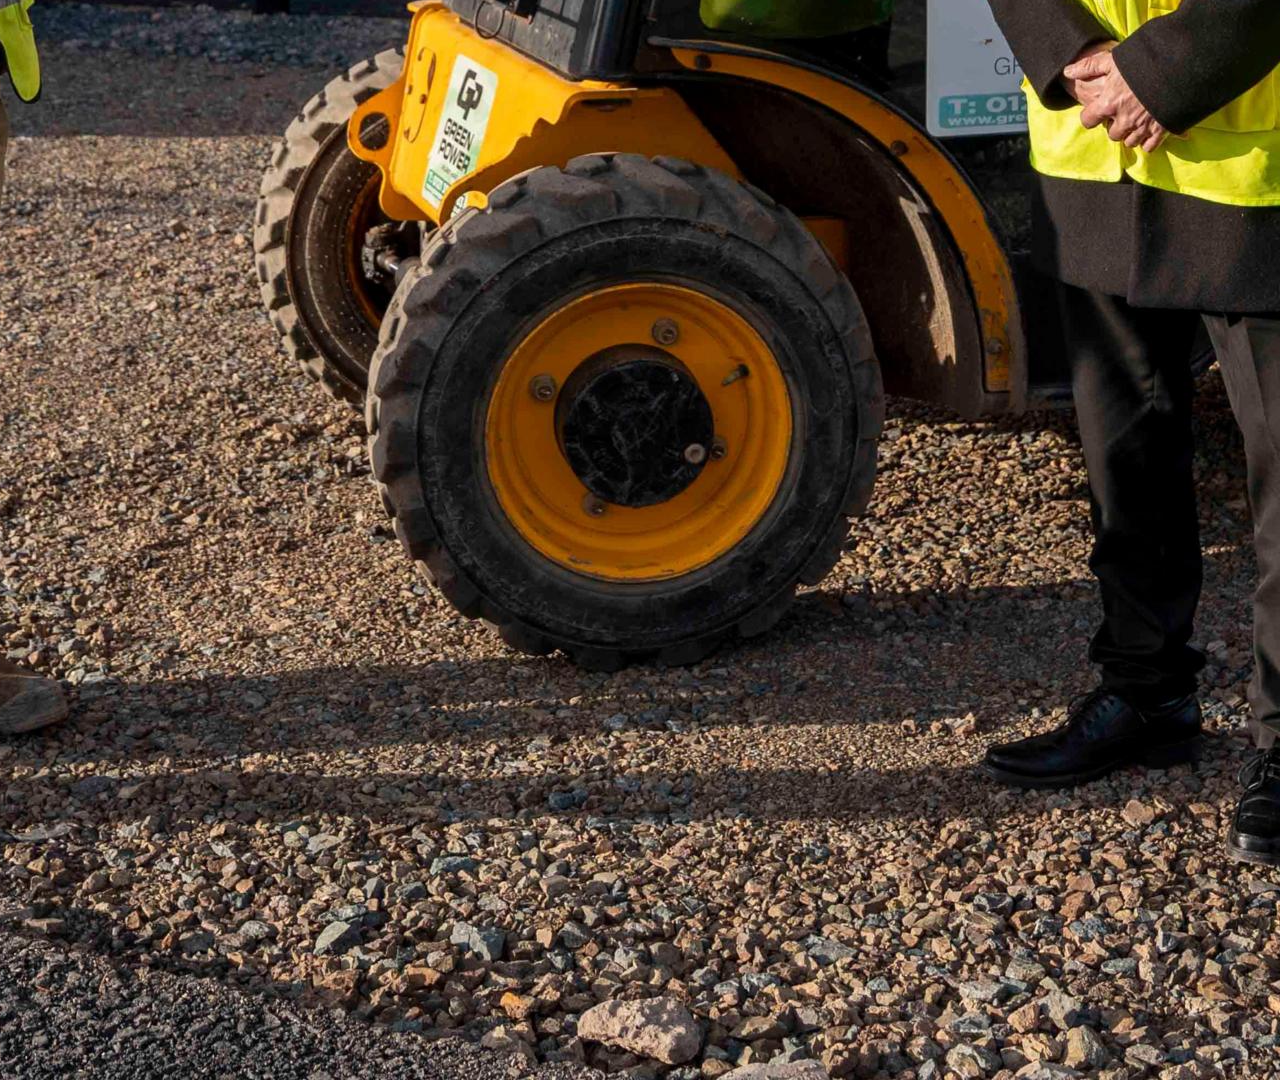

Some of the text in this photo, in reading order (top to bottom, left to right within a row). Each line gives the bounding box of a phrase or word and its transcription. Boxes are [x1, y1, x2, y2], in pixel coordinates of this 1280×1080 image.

[948, 98, 976, 115] T:
[948, 114, 1026, 126] www.gre
[443, 118, 475, 151] GREEN
[439, 139, 471, 174] POWER
